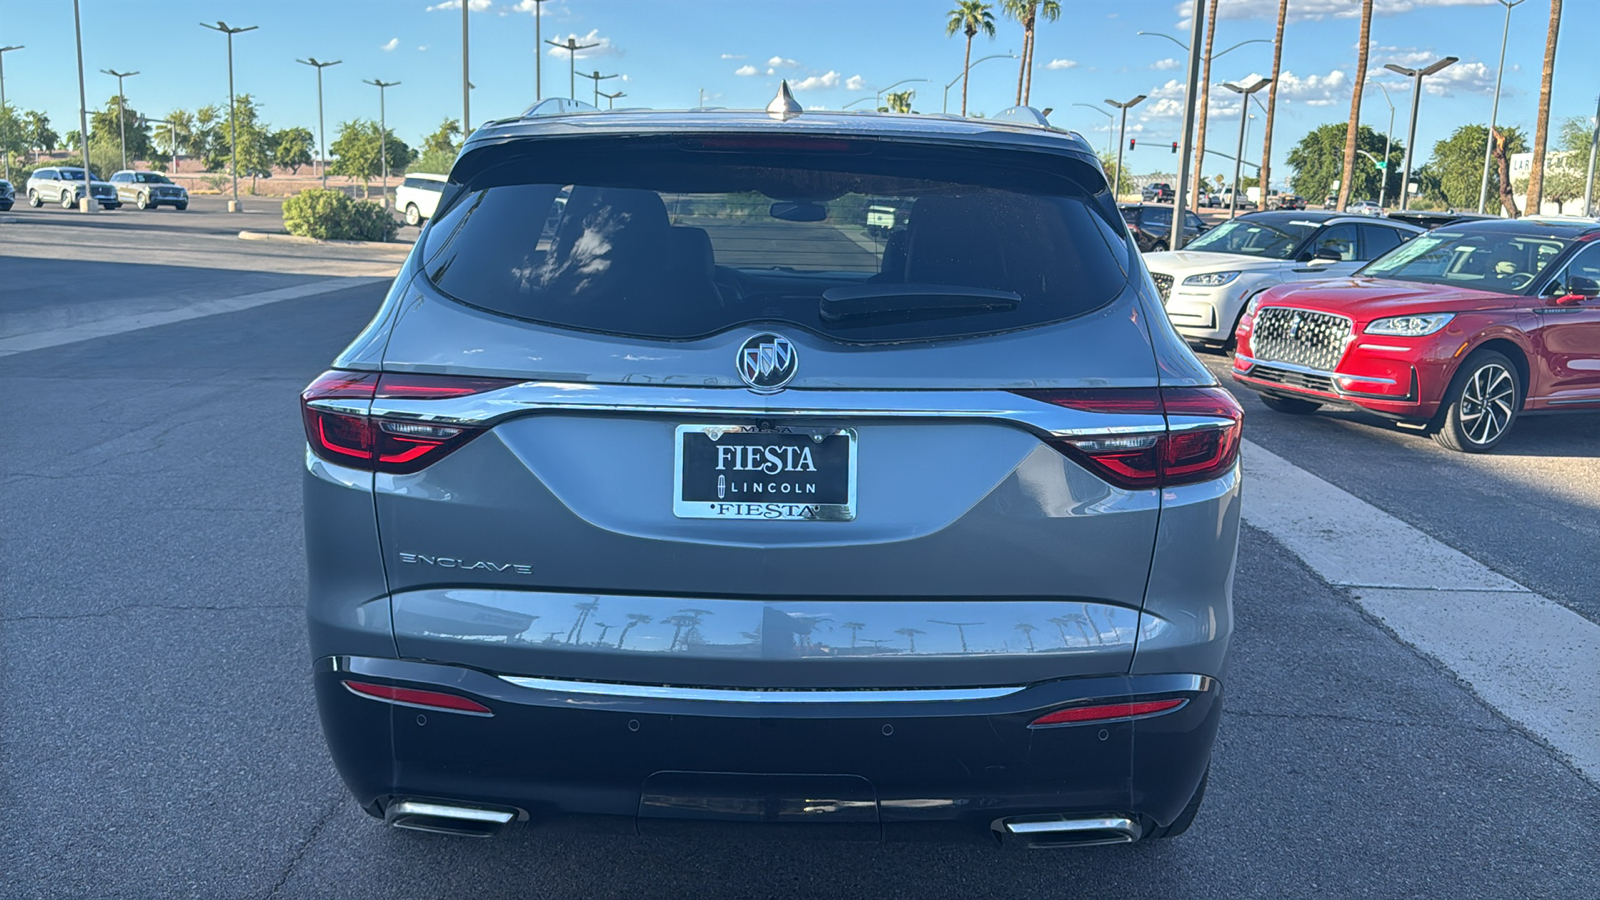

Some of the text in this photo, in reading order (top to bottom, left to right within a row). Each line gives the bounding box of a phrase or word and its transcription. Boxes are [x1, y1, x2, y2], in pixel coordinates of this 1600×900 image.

[715, 445, 817, 475] FIESTA
[731, 482, 816, 494] LINCOLN
[717, 503, 816, 519] FIESTA
[399, 552, 533, 575] ENCLAVE
